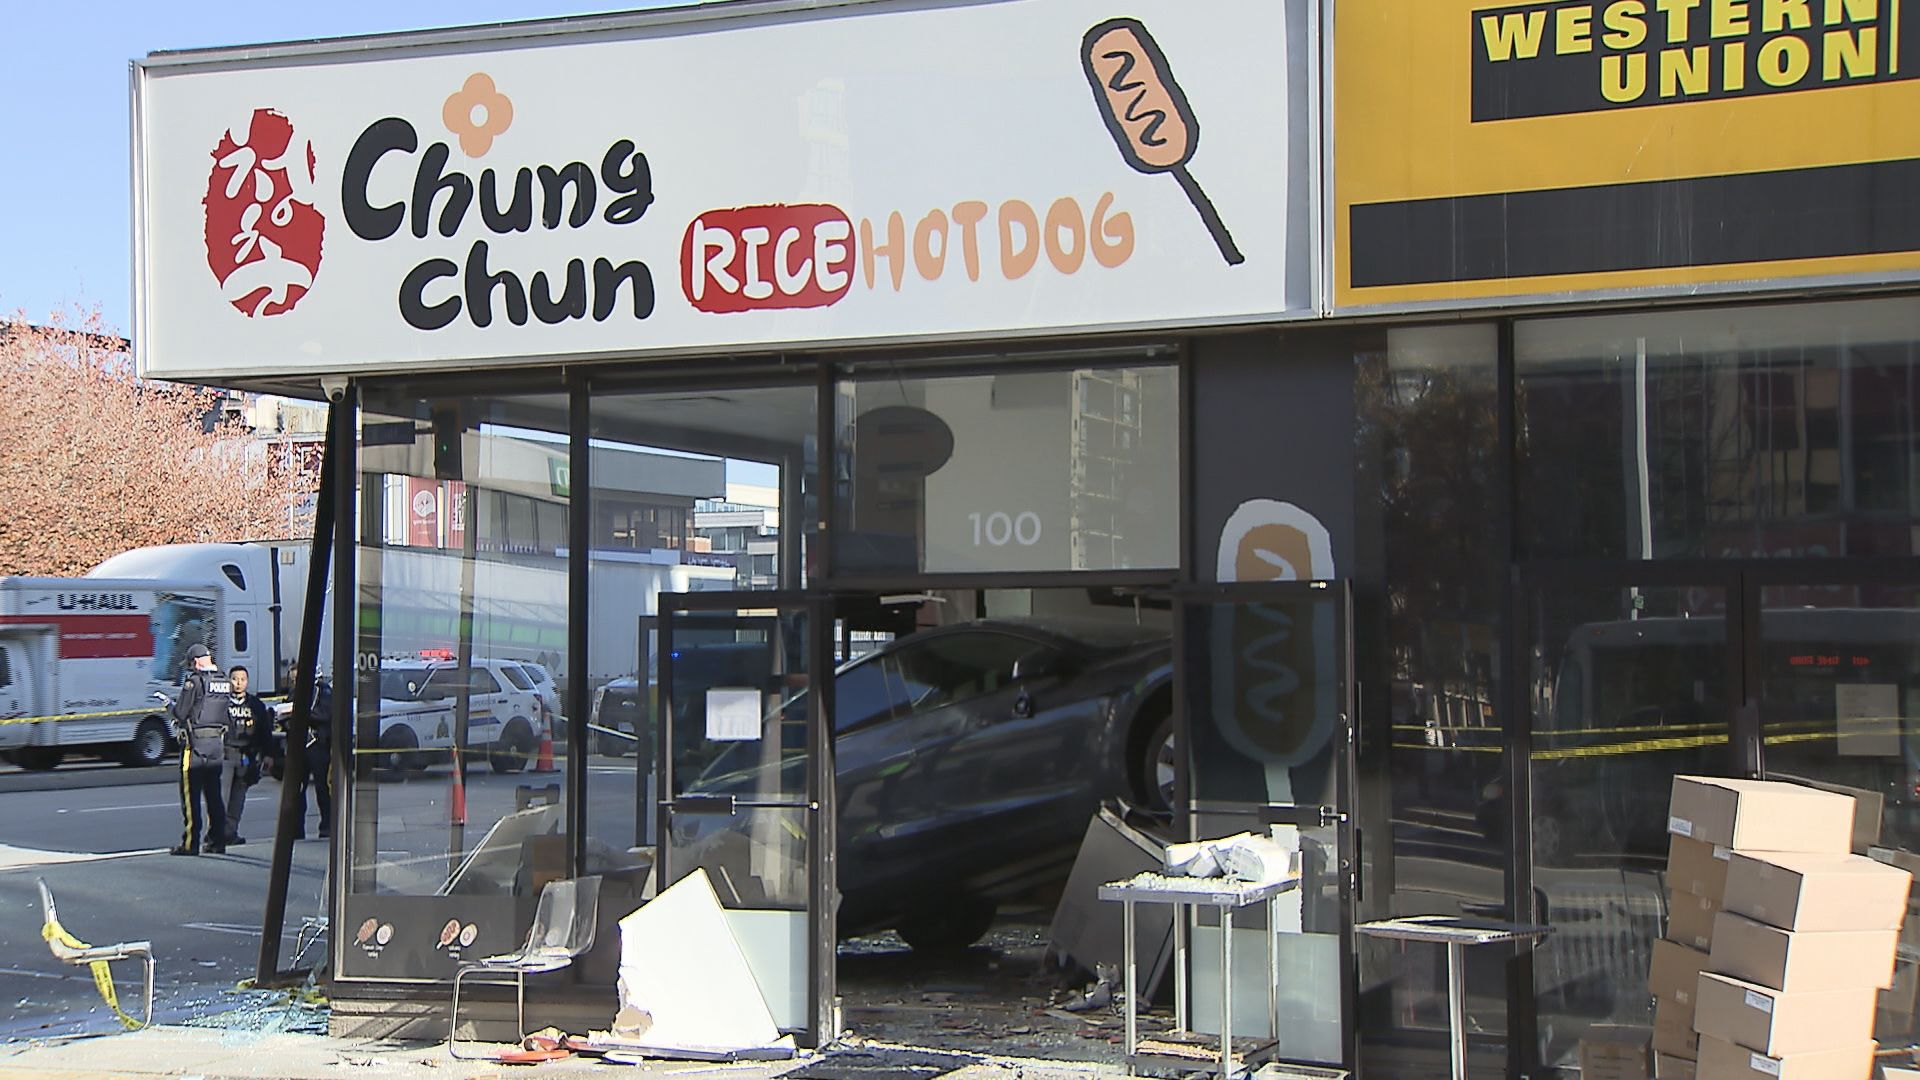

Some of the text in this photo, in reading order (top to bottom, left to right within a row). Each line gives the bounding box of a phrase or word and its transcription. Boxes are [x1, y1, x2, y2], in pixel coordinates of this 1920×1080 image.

[1600, 28, 1877, 103] UNION
[341, 117, 655, 241] Chung
[398, 239, 655, 331] chun
[691, 219, 850, 301] RICE
[968, 511, 1042, 546] 100
[57, 594, 138, 610] U-HAUL
[209, 682, 231, 693] POLICE
[229, 706, 252, 717] POLICE
